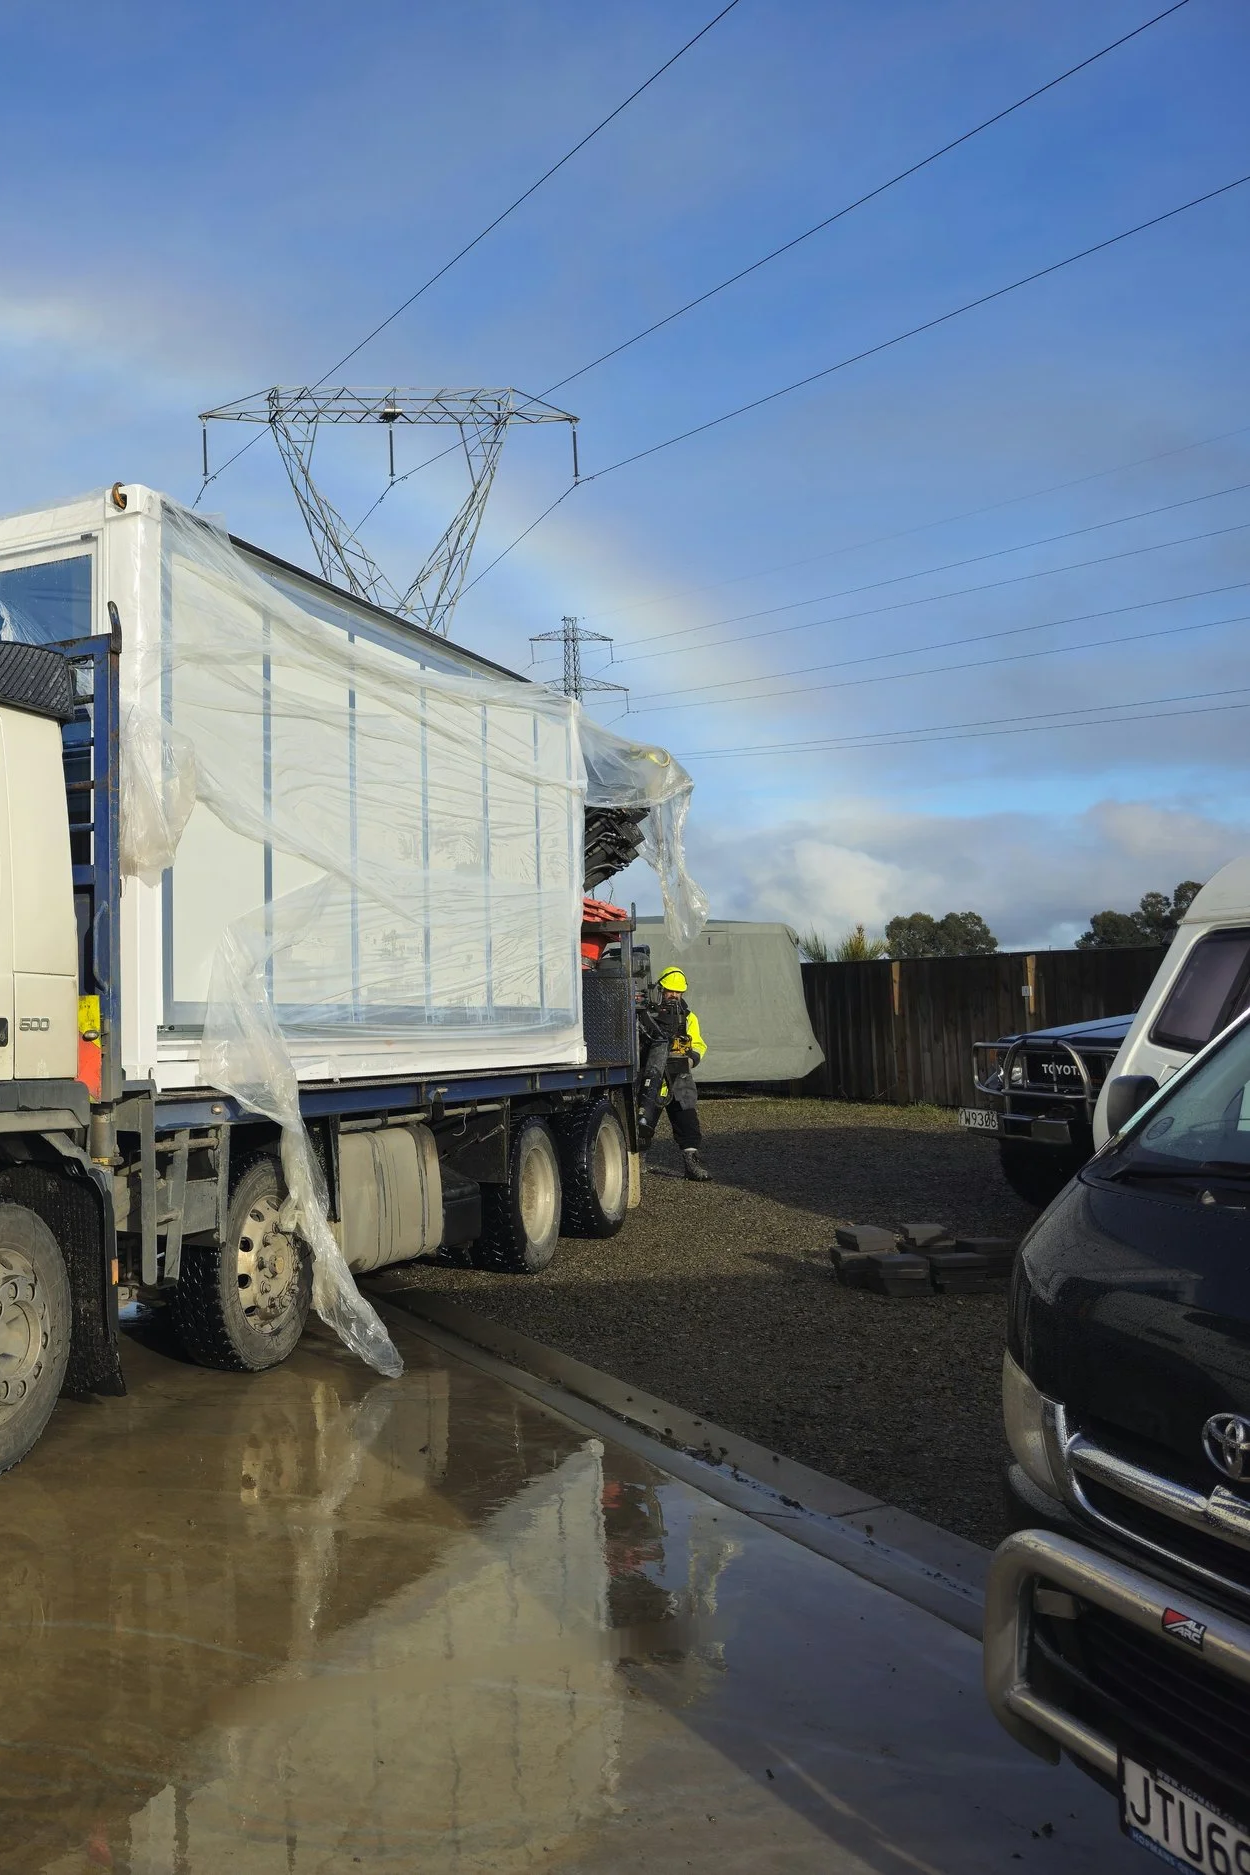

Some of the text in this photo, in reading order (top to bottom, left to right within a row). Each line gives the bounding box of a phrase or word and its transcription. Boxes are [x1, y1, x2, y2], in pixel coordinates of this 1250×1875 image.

[19, 1018, 50, 1031] 500
[1042, 1064, 1080, 1075] TOYOT
[1171, 1626, 1200, 1644] ARC
